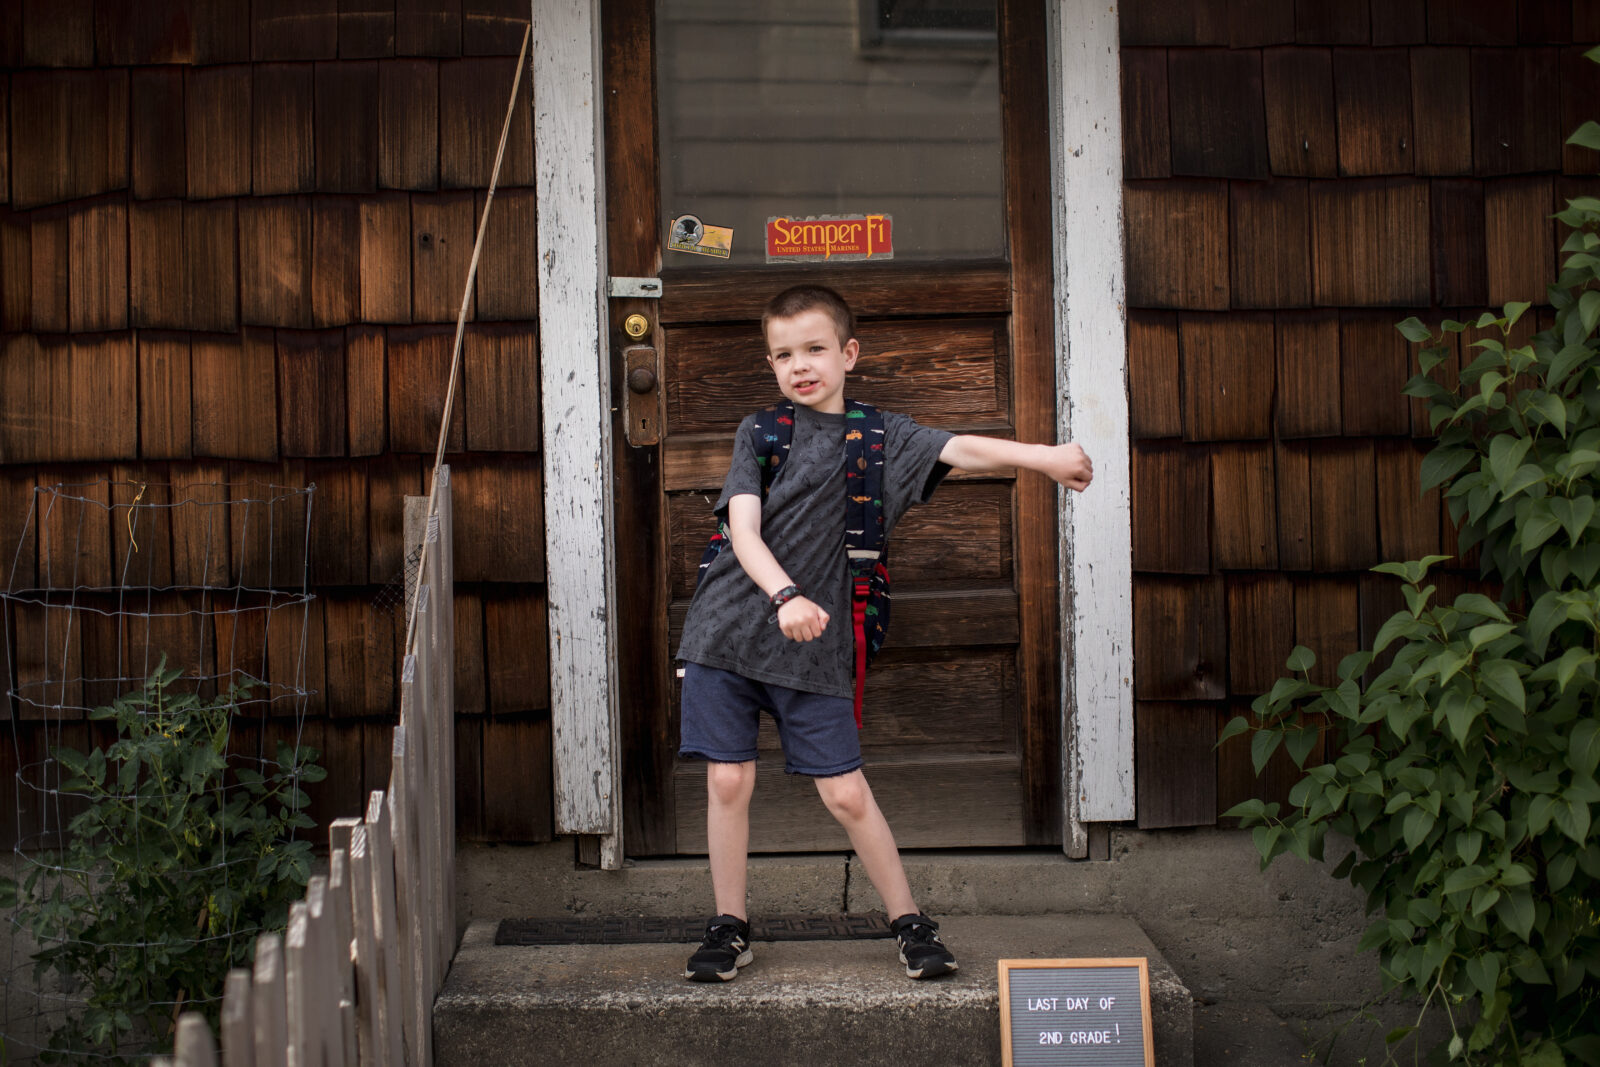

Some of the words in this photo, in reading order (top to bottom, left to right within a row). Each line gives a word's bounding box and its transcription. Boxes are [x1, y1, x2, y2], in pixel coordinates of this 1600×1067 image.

[774, 218, 862, 260] Semper
[866, 215, 884, 259] Fi
[1028, 998, 1059, 1011] LAST
[1066, 997, 1089, 1010] DAY
[1099, 997, 1116, 1011] OF
[1039, 1031, 1063, 1044] 2ND
